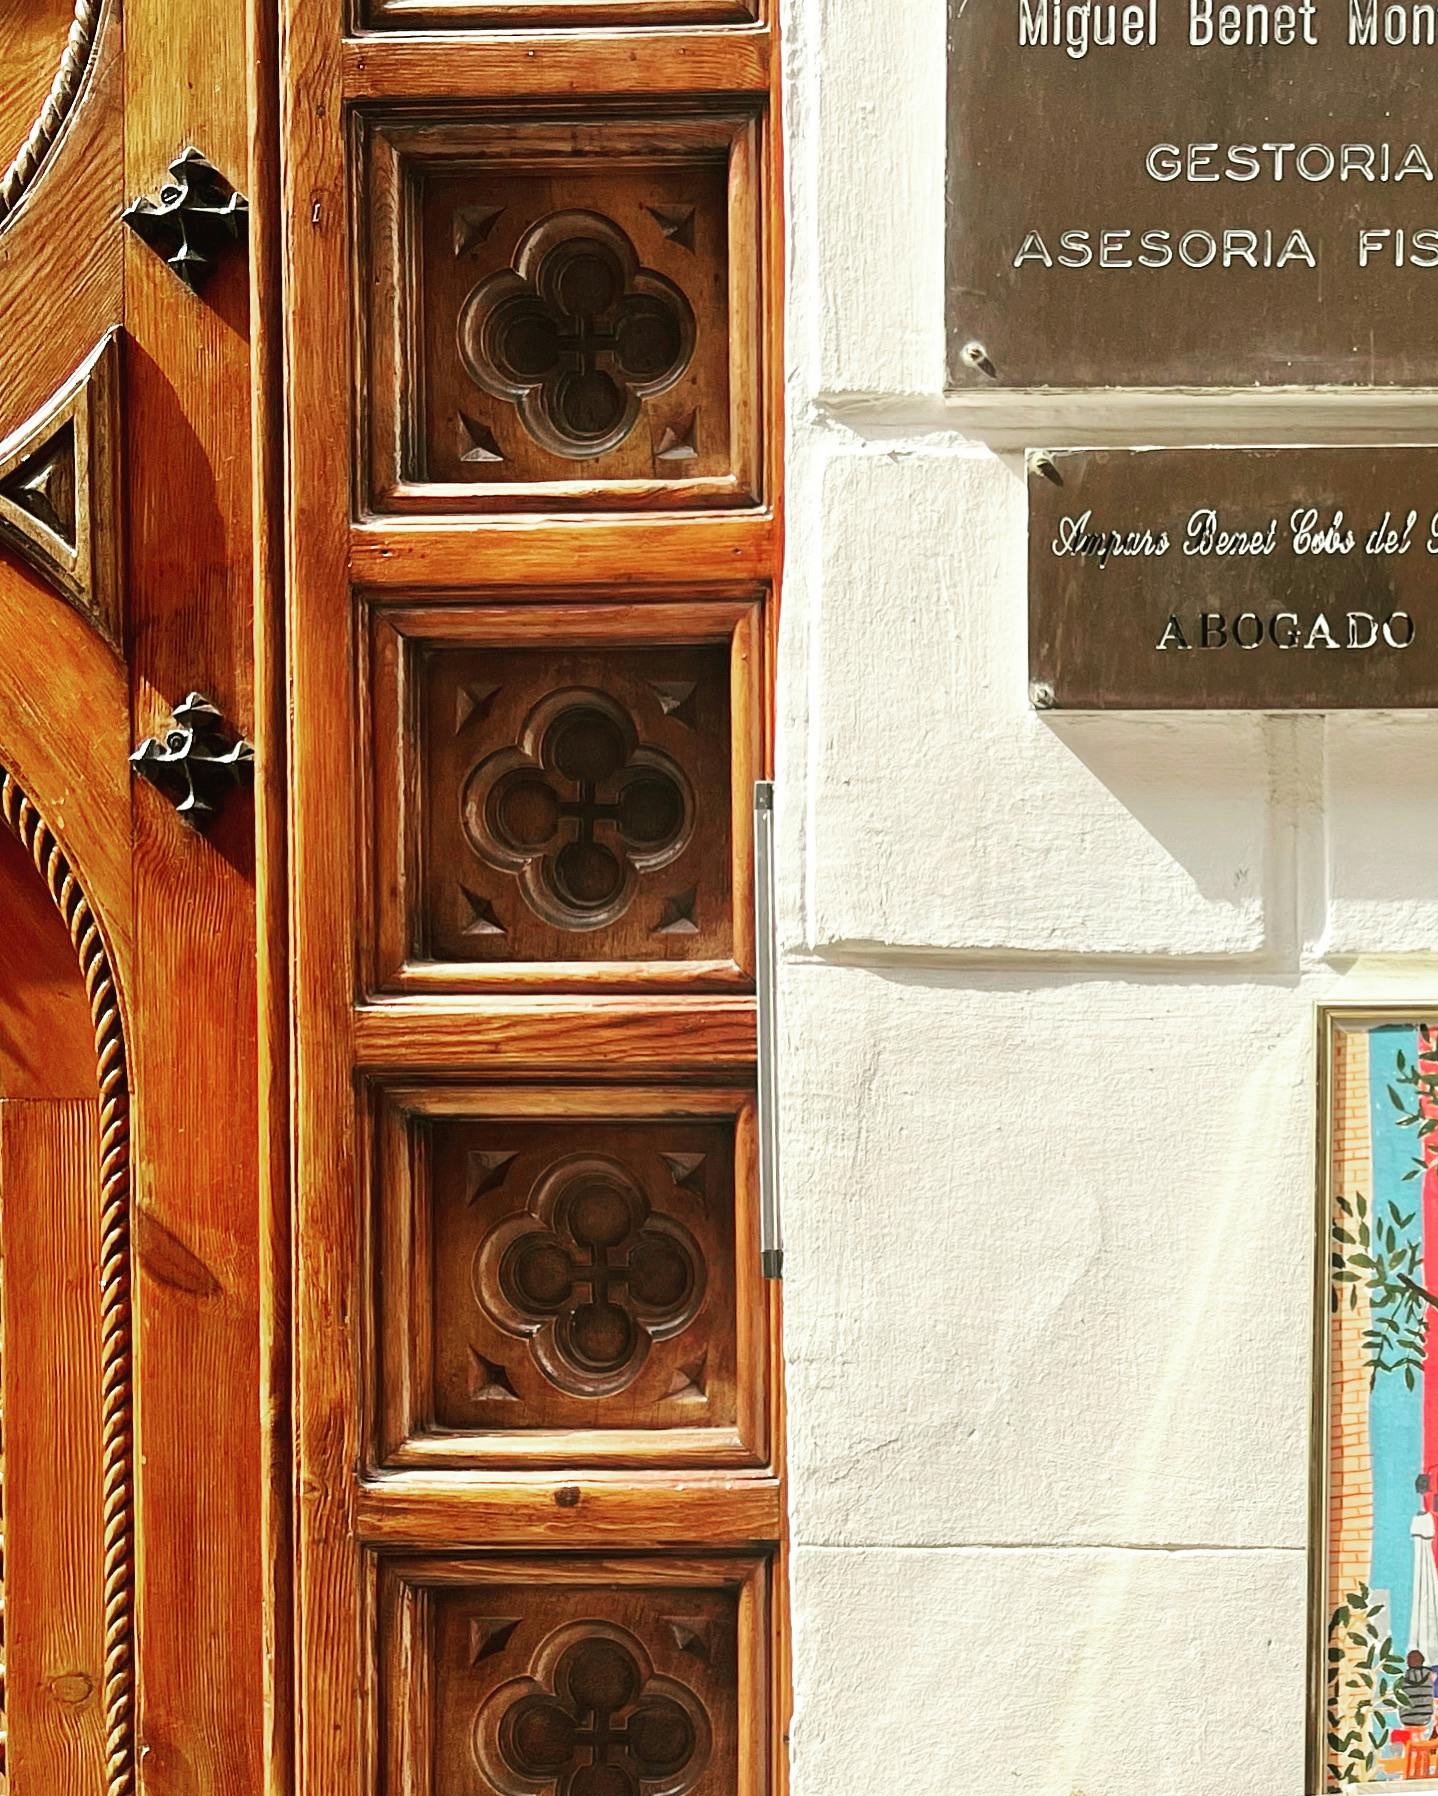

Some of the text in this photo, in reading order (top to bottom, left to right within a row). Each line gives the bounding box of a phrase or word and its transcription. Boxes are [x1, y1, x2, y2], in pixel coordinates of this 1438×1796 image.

[1018, 0, 1157, 58] Miguel
[1189, 0, 1318, 46] Benet
[1145, 143, 1434, 182] GESTORIA
[1013, 229, 1316, 268] ASESORIA
[1051, 510, 1169, 569] Amparo
[1183, 509, 1276, 556] Benet
[1364, 509, 1418, 555] del
[1155, 612, 1416, 650] ABOGADO
